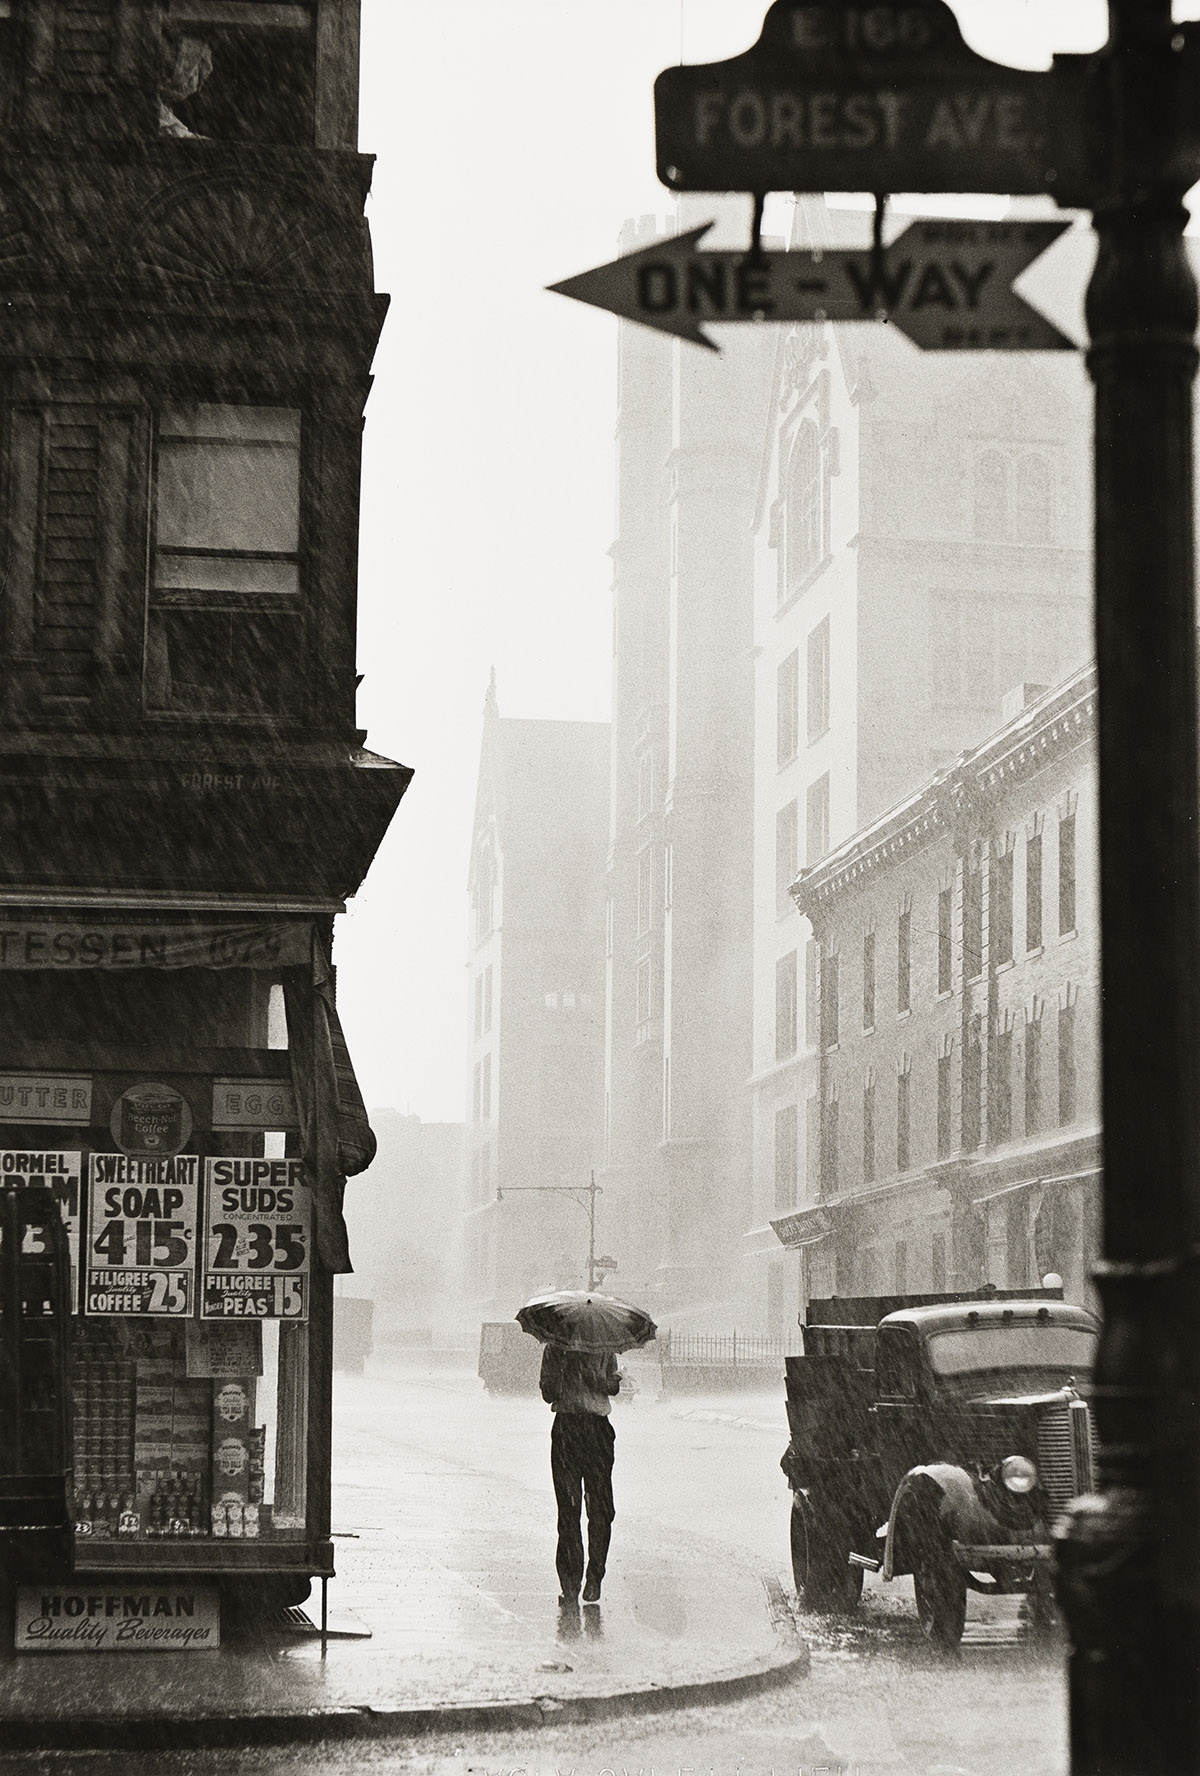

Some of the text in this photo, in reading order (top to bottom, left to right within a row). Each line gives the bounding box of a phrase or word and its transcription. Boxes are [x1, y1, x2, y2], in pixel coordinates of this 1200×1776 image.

[694, 89, 906, 149] FOREST
[637, 261, 772, 313] ONE
[846, 260, 995, 313] WAY
[181, 774, 244, 791] FOREST
[0, 931, 167, 965] TESSEN
[0, 1086, 88, 1109] UTTER
[226, 1094, 290, 1116] EGG
[134, 1123, 169, 1134] Coffee
[0, 1153, 69, 1174] ORMEL
[95, 1155, 197, 1185] SWEETHEART
[214, 1160, 308, 1187] SUPER
[105, 1187, 184, 1219] SOAP
[222, 1187, 294, 1213] SUDS
[223, 1213, 293, 1221] CONCENTRATED
[91, 1271, 149, 1286] FILIGREE
[206, 1275, 271, 1290] FILIGREE
[90, 1294, 141, 1312] COFFEE
[223, 1297, 268, 1315] PEAS
[41, 1596, 195, 1617] HOFFMAN
[25, 1617, 211, 1646] Quality Beverages
